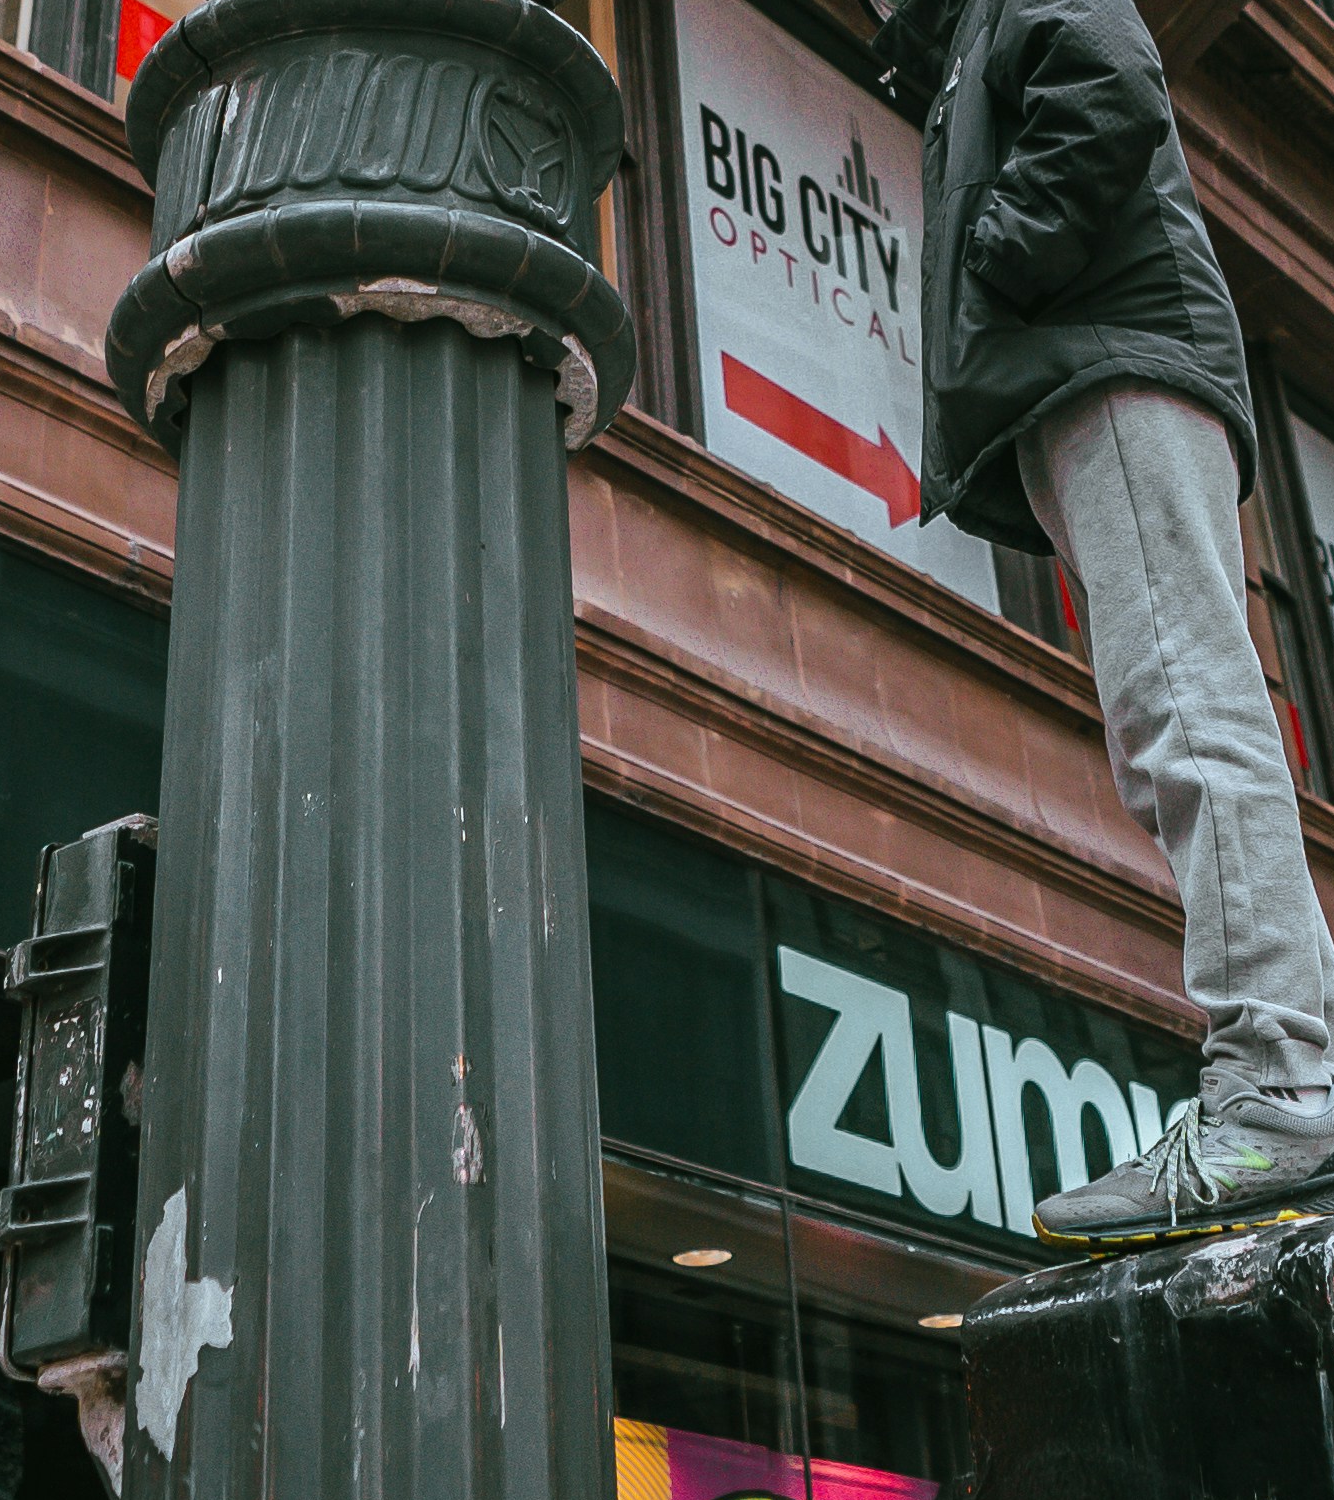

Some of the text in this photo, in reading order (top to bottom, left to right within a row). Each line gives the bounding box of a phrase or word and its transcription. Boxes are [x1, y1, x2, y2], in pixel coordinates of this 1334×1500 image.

[700, 103, 900, 312] BIG CITY
[709, 207, 917, 367] OPTICAL
